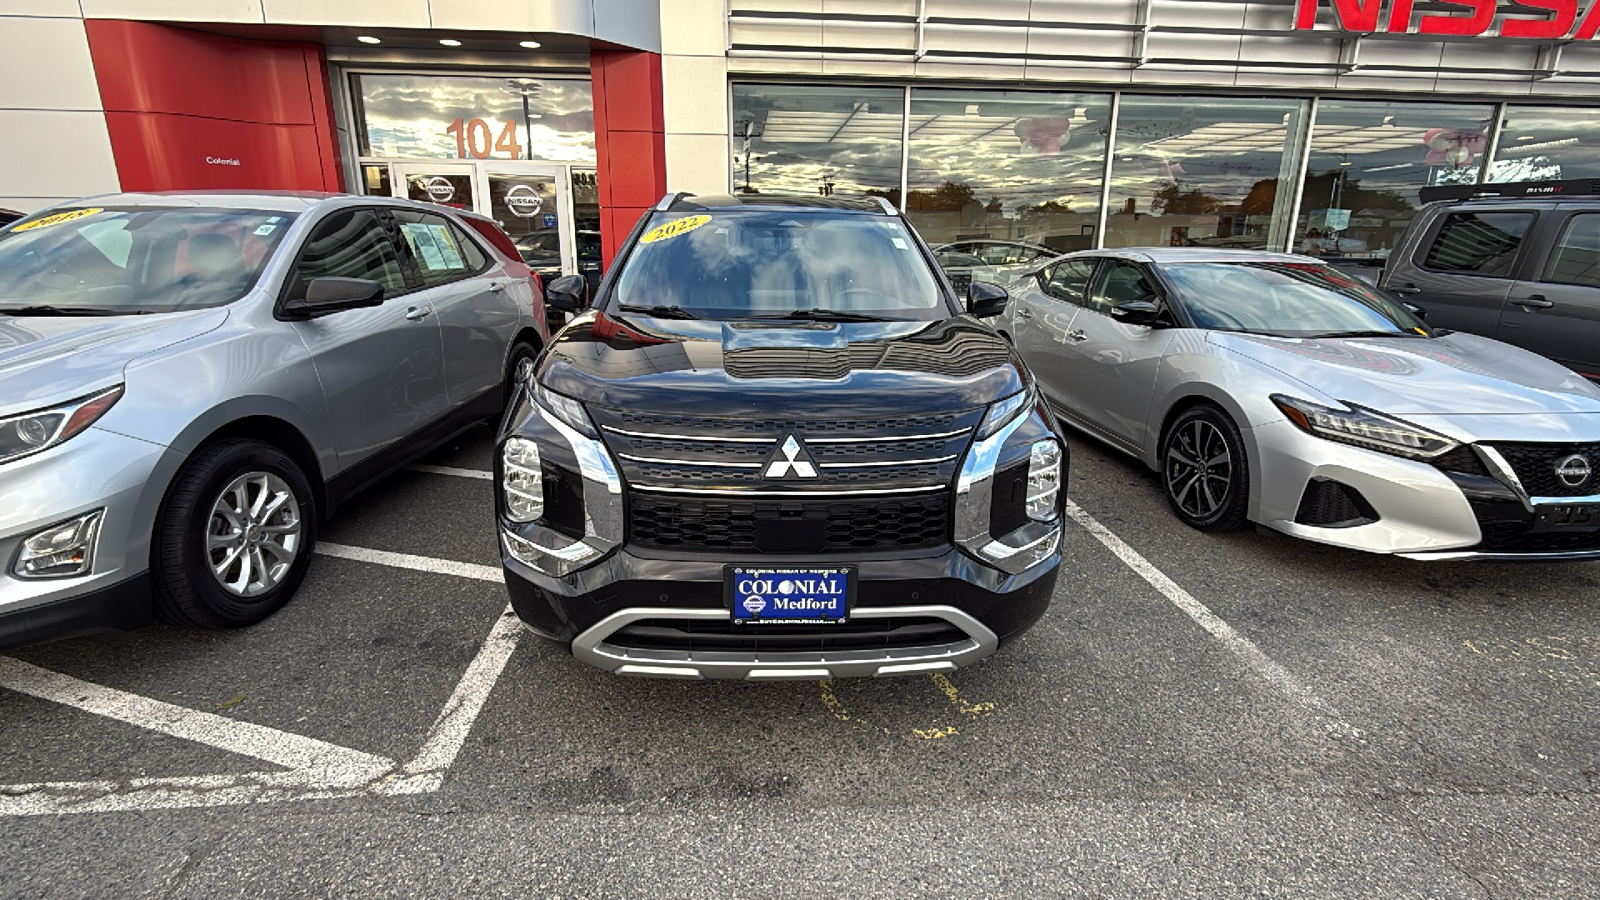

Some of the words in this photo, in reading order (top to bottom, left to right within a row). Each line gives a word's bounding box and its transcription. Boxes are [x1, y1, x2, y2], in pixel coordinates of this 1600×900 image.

[1295, 0, 1600, 40] NISS
[446, 117, 522, 160] 104
[206, 156, 241, 166] Colonial
[507, 197, 541, 206] NISSAN
[654, 217, 699, 240] 2022
[738, 579, 842, 595] COLONIAL
[773, 597, 837, 610] Medford
